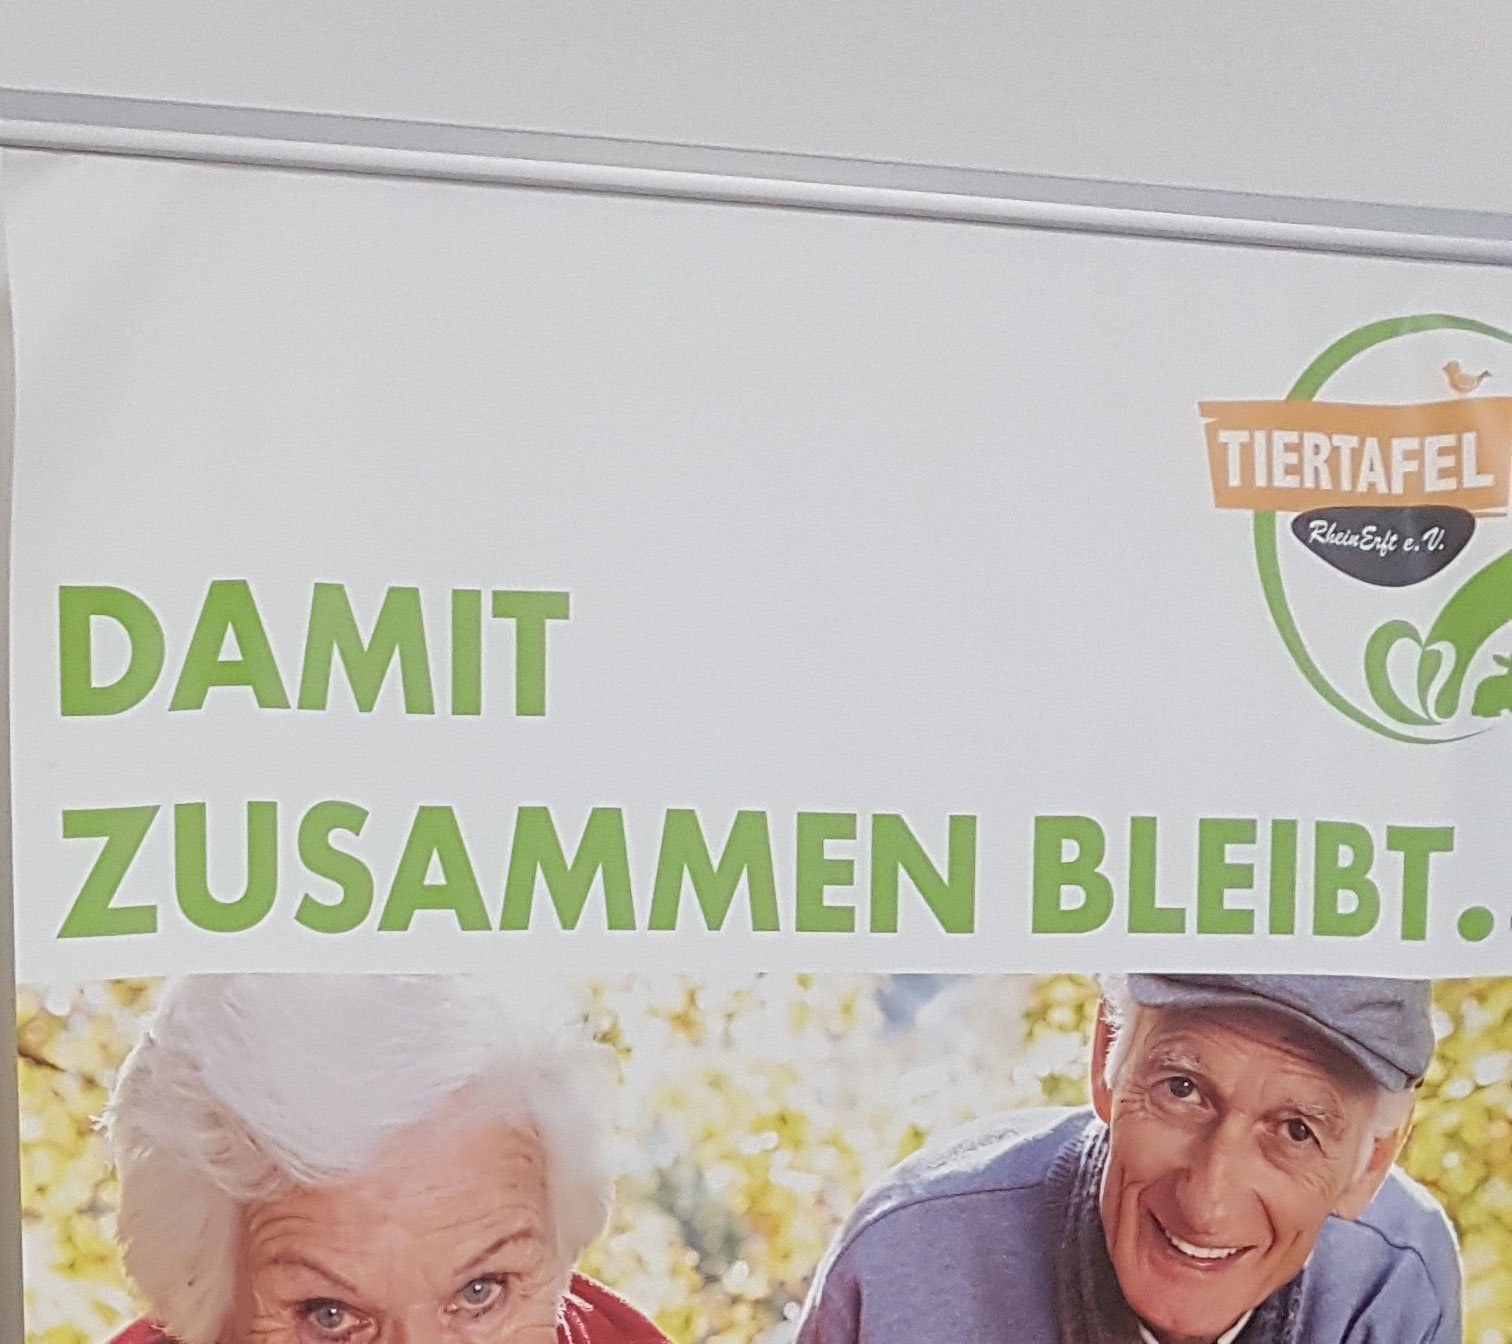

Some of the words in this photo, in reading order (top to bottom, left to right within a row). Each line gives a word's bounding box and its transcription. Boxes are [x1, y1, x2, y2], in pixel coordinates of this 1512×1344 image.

[1218, 430, 1494, 494] TIERTAFEL
[1309, 519, 1398, 557] RheinErft
[1403, 527, 1445, 551] e.V.
[58, 578, 571, 718] DAMIT
[55, 800, 980, 940] ZUSAMMEN
